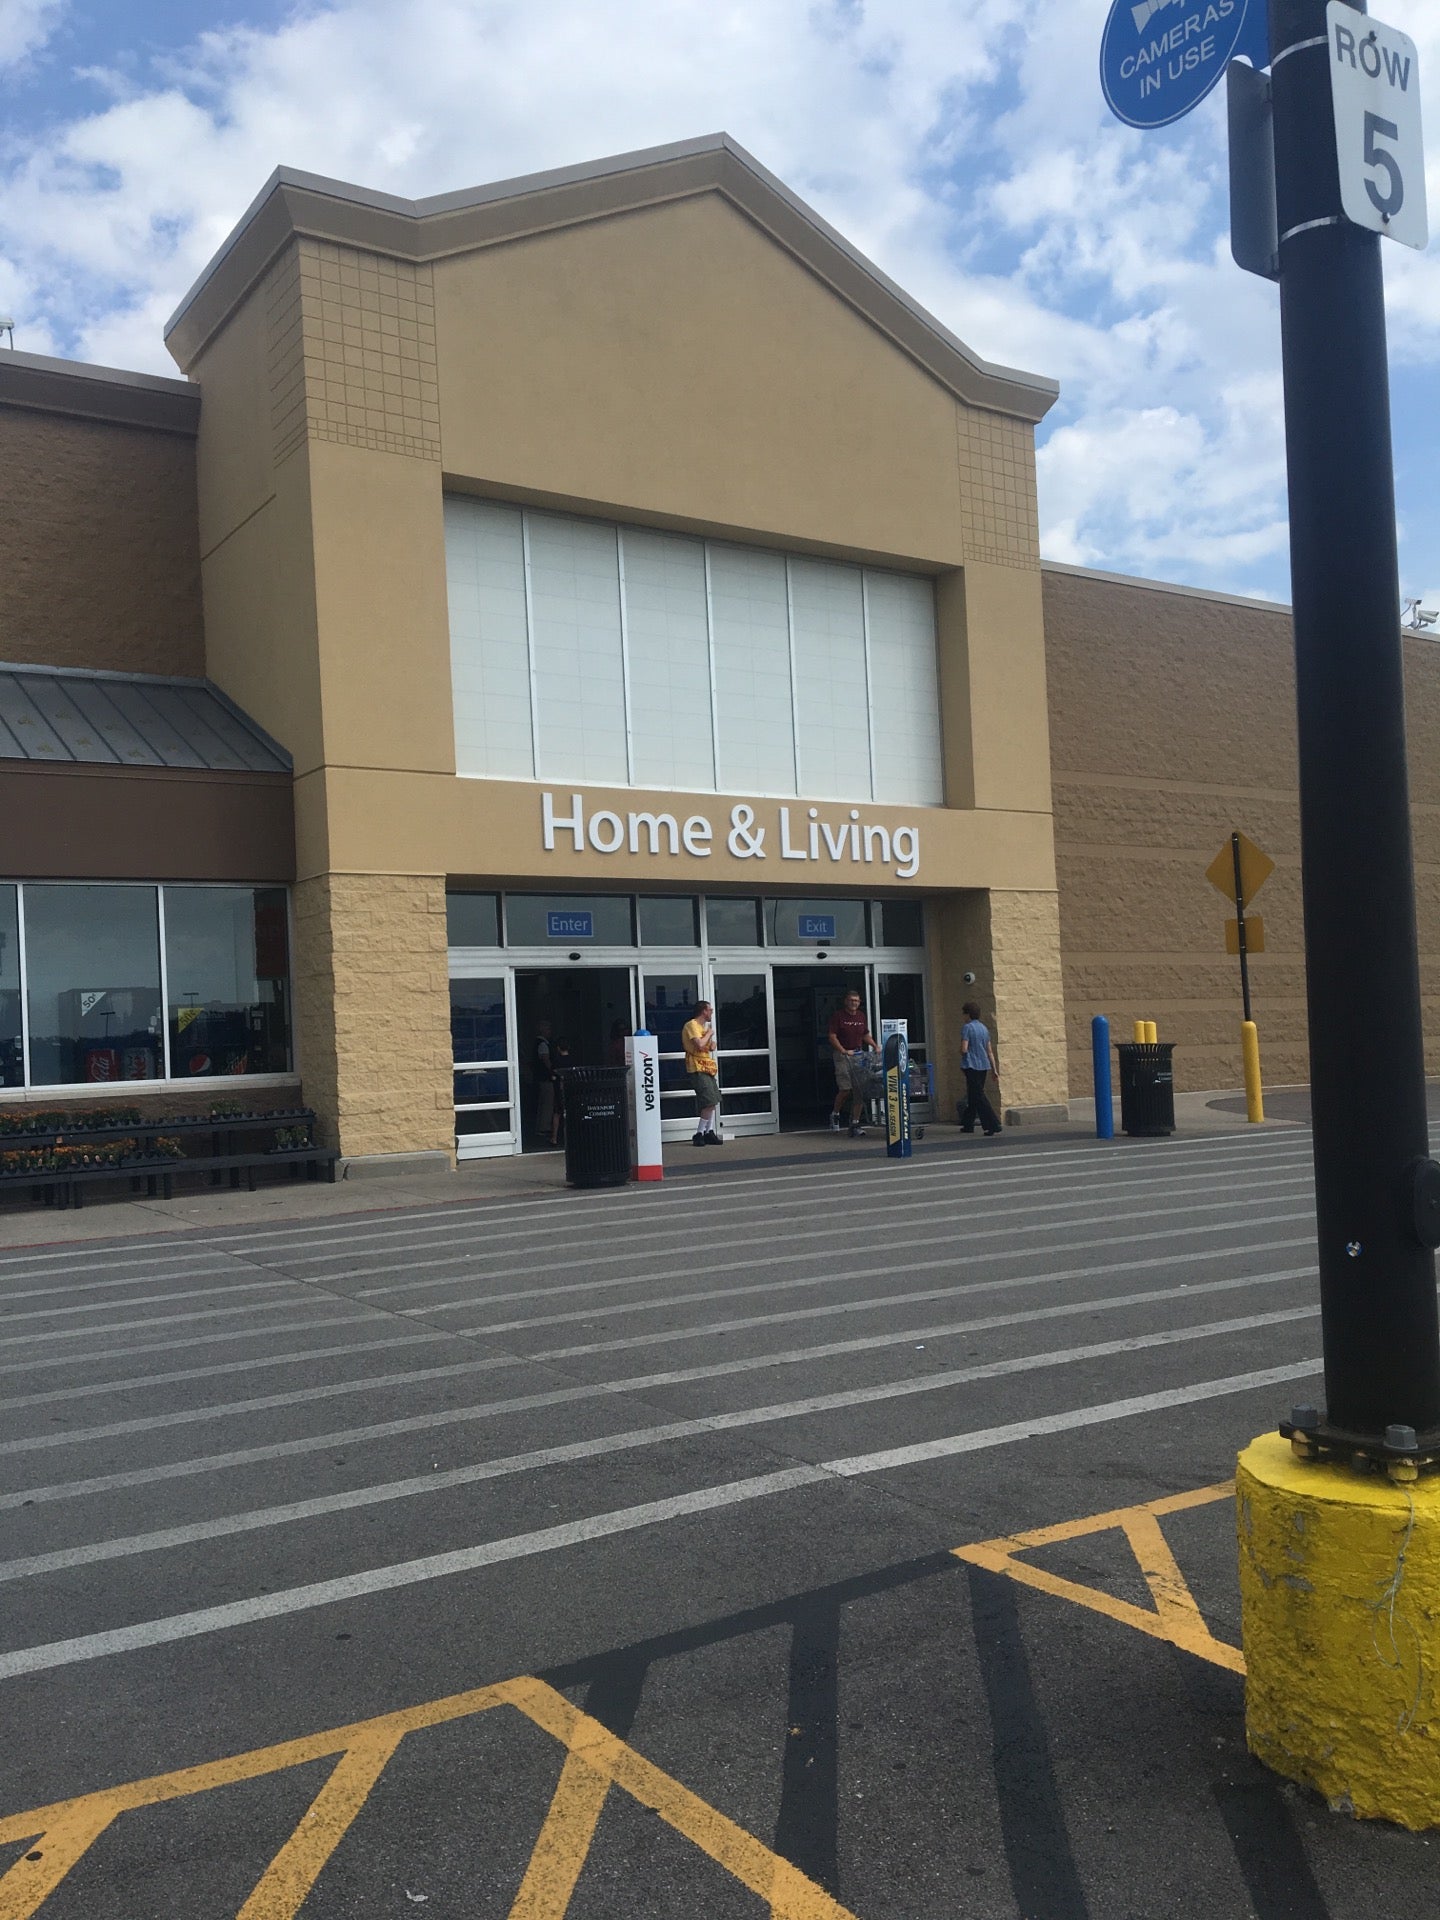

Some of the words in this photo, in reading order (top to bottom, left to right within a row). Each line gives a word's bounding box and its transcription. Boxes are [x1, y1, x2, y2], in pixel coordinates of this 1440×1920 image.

[1120, 0, 1234, 79] CAMERAS
[1140, 68, 1161, 99] IN
[1168, 35, 1216, 80] USE
[1335, 23, 1411, 92] ROW
[1363, 110, 1404, 216] 5
[541, 792, 713, 857] Home
[727, 804, 766, 859] &
[779, 806, 920, 878] Living
[551, 916, 588, 931] Enter
[806, 919, 828, 933] Exit
[641, 1057, 655, 1112] verizon
[887, 1075, 898, 1093] VIVA
